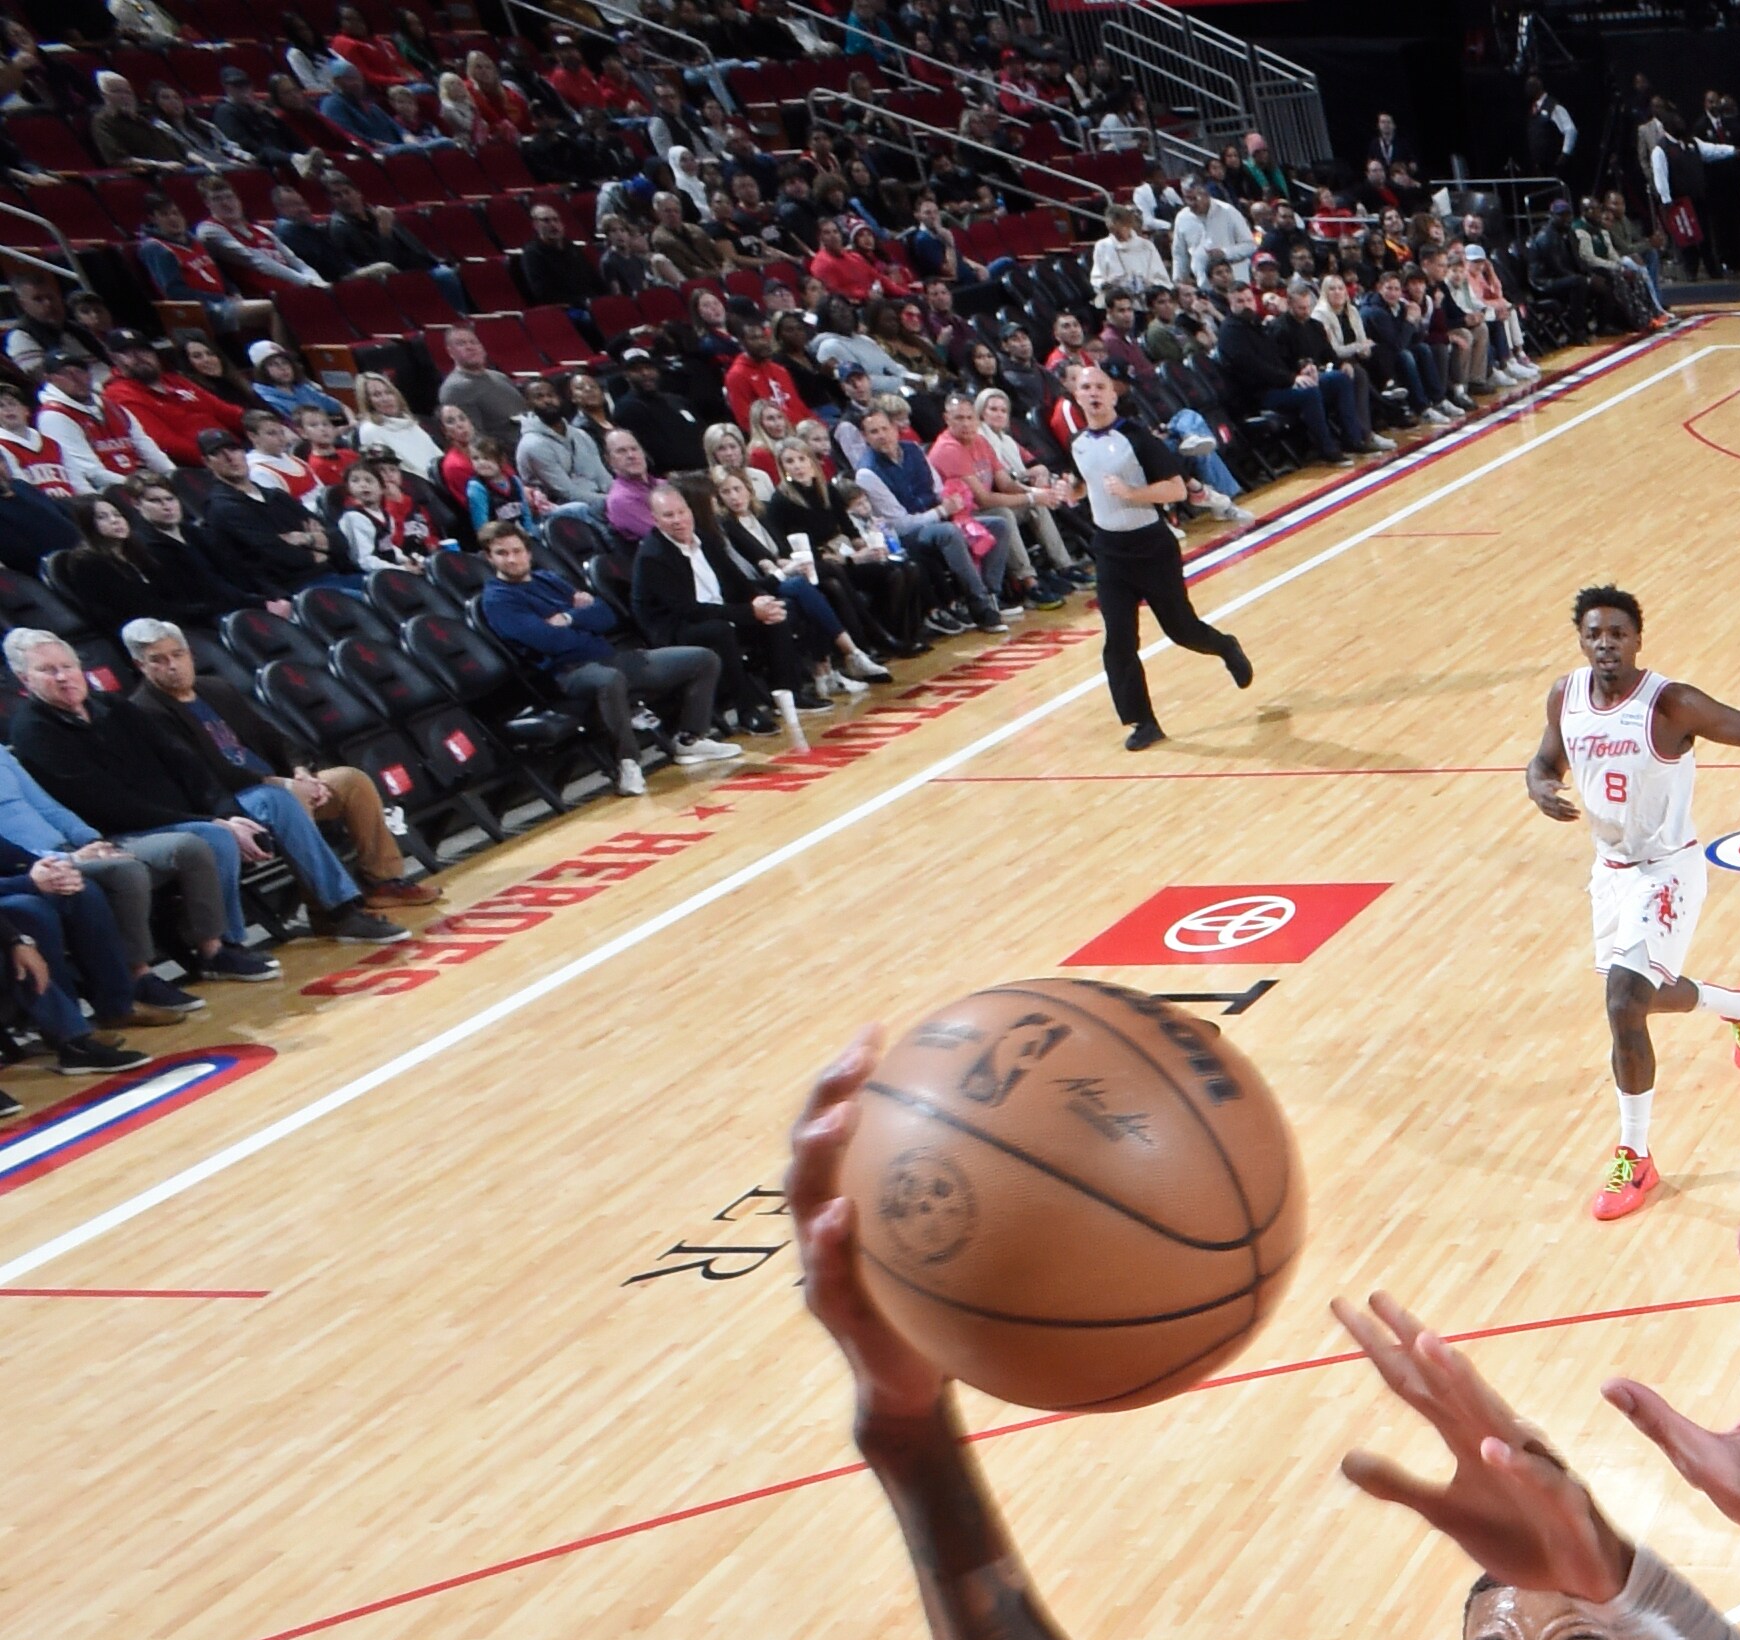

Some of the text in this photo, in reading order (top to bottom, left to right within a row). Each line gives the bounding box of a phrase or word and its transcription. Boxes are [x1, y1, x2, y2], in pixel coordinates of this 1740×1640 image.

[716, 629, 1102, 792] HOMETOWN
[1567, 733, 1641, 763] H-Town
[1605, 772, 1627, 803] 8
[300, 831, 717, 997] HEROES
